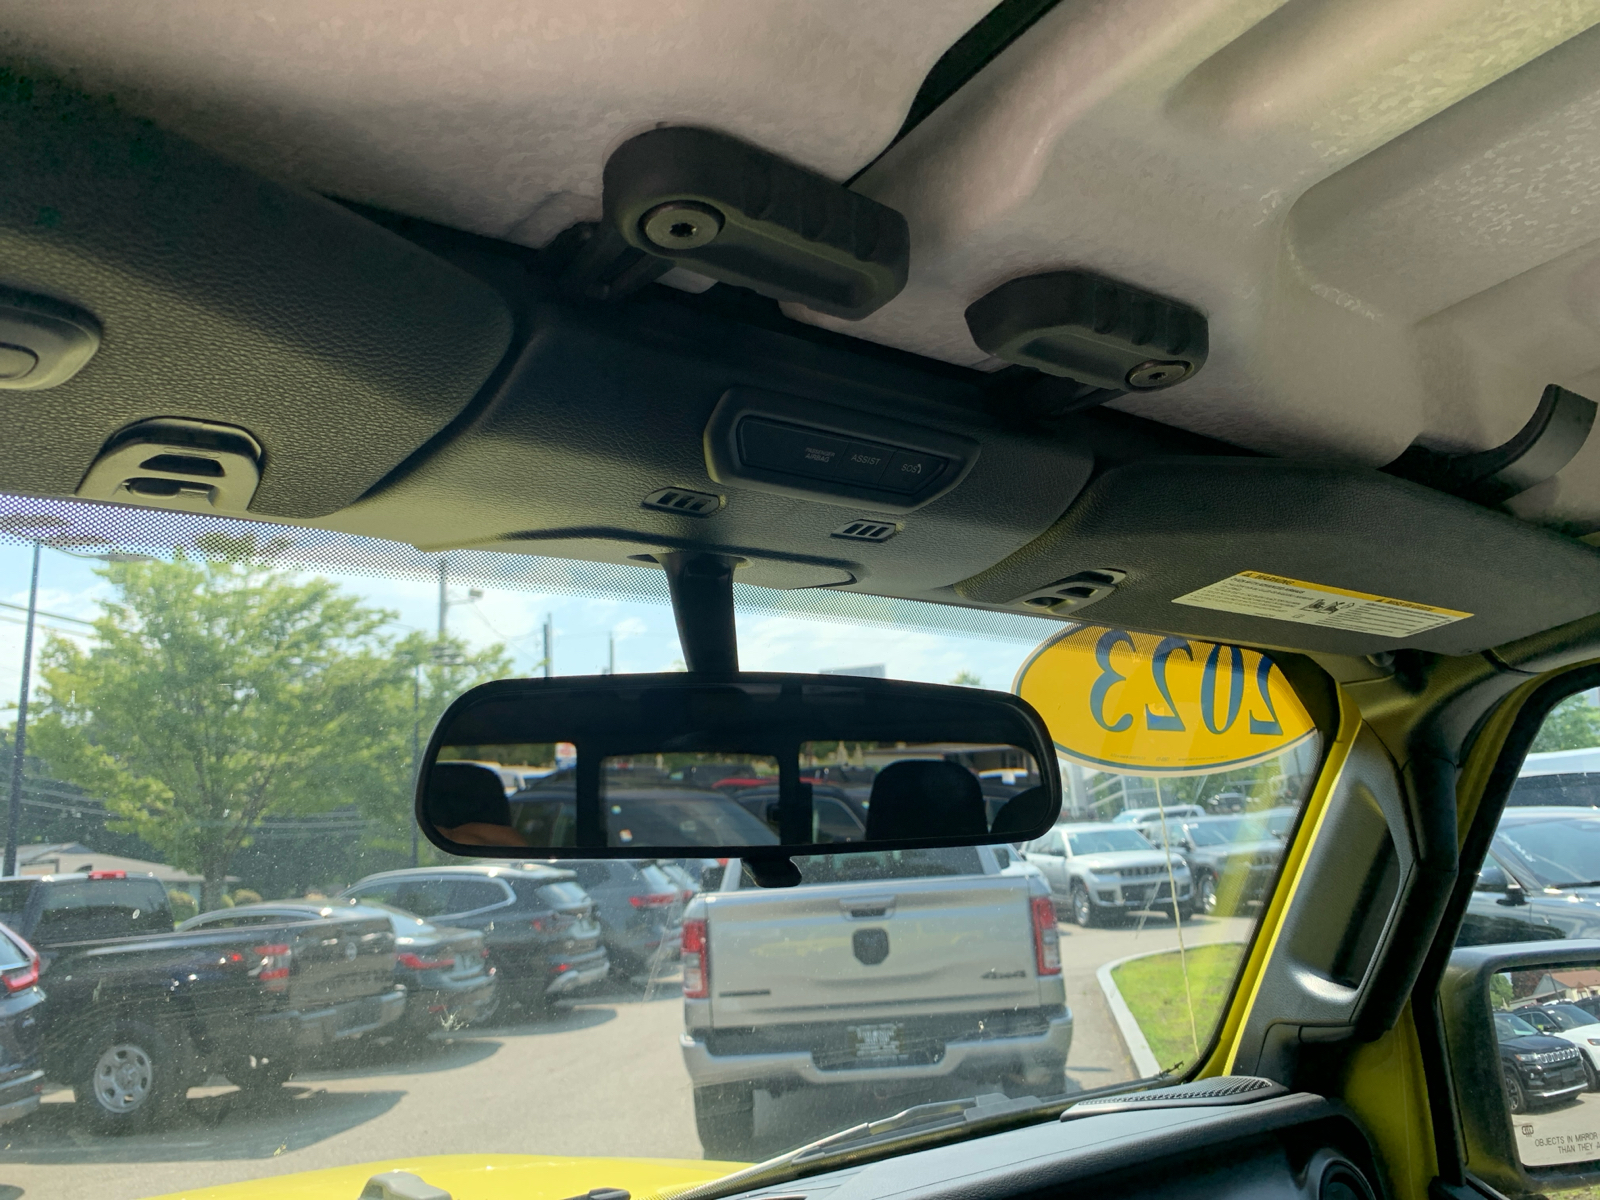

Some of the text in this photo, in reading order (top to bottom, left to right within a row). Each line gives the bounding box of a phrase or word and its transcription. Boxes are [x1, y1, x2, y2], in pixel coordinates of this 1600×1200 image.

[805, 453, 830, 463] AIRBAG
[850, 454, 881, 466] ASSIST
[901, 463, 918, 473] SOS
[1534, 1132, 1598, 1147] OBJECTS IN MIRROR
[1558, 1145, 1576, 1154] THAN
[1577, 1142, 1593, 1152] THEY
